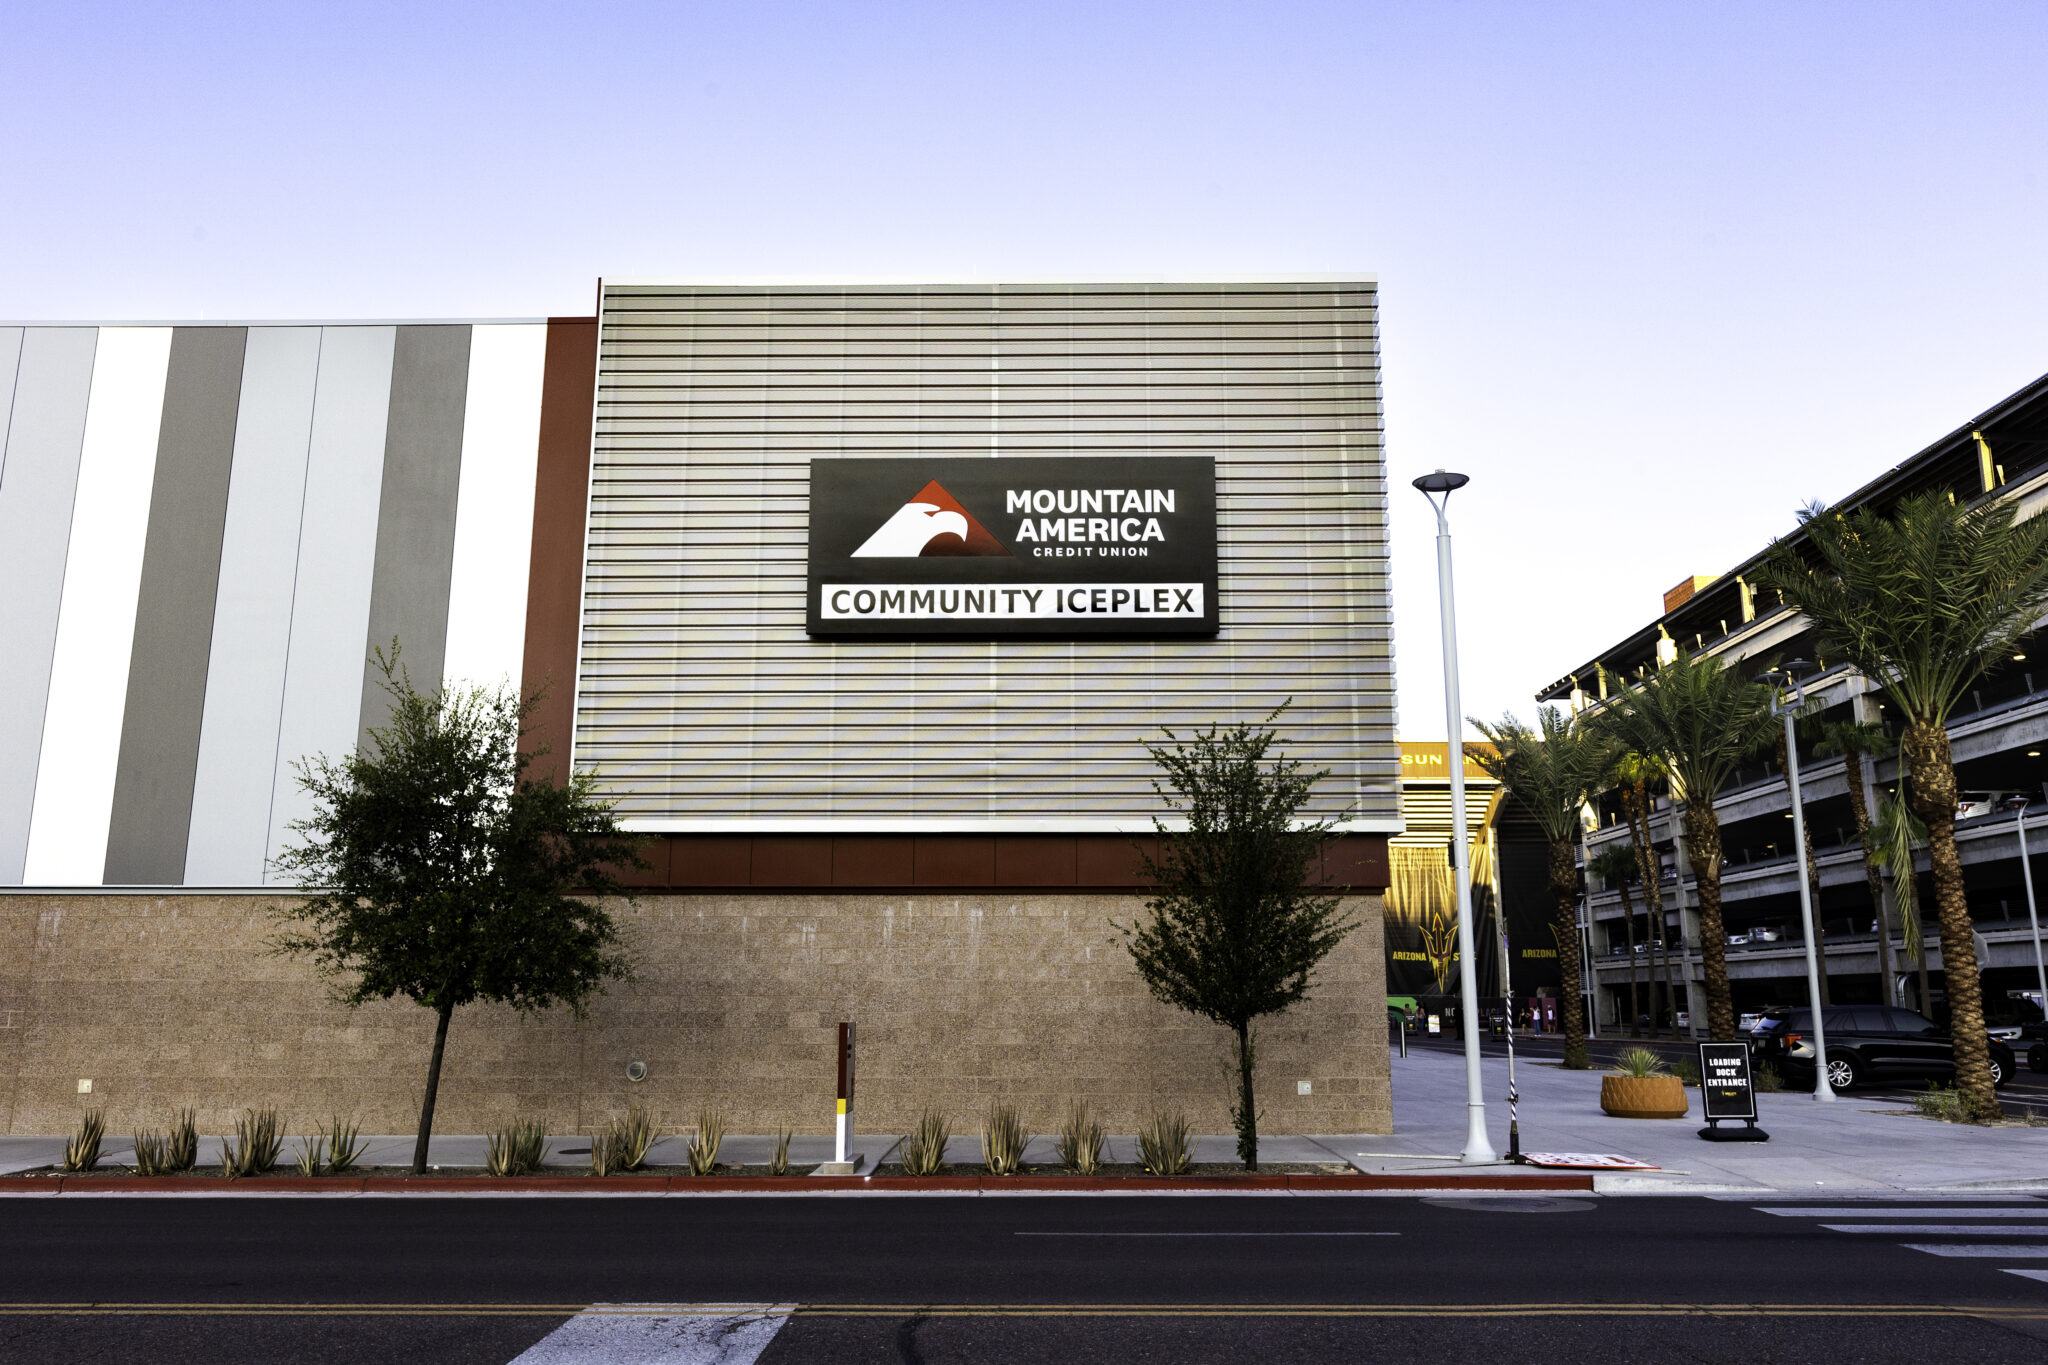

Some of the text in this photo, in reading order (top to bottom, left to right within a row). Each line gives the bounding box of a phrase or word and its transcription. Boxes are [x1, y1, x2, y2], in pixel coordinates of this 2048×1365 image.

[1006, 489, 1176, 514] MOUNTAIN
[1015, 518, 1166, 542] AMERICA
[1032, 547, 1149, 557] CREDIT UNION
[831, 588, 1195, 614] COMMUNITY ICEPLEX
[1401, 754, 1442, 765] SUN
[1392, 951, 1427, 961] ARIZONA
[1522, 948, 1557, 958] ARIZONA
[1709, 1058, 1742, 1066] LOADING
[1716, 1068, 1737, 1076] DOCK
[1708, 1079, 1748, 1087] ENTRANCE
